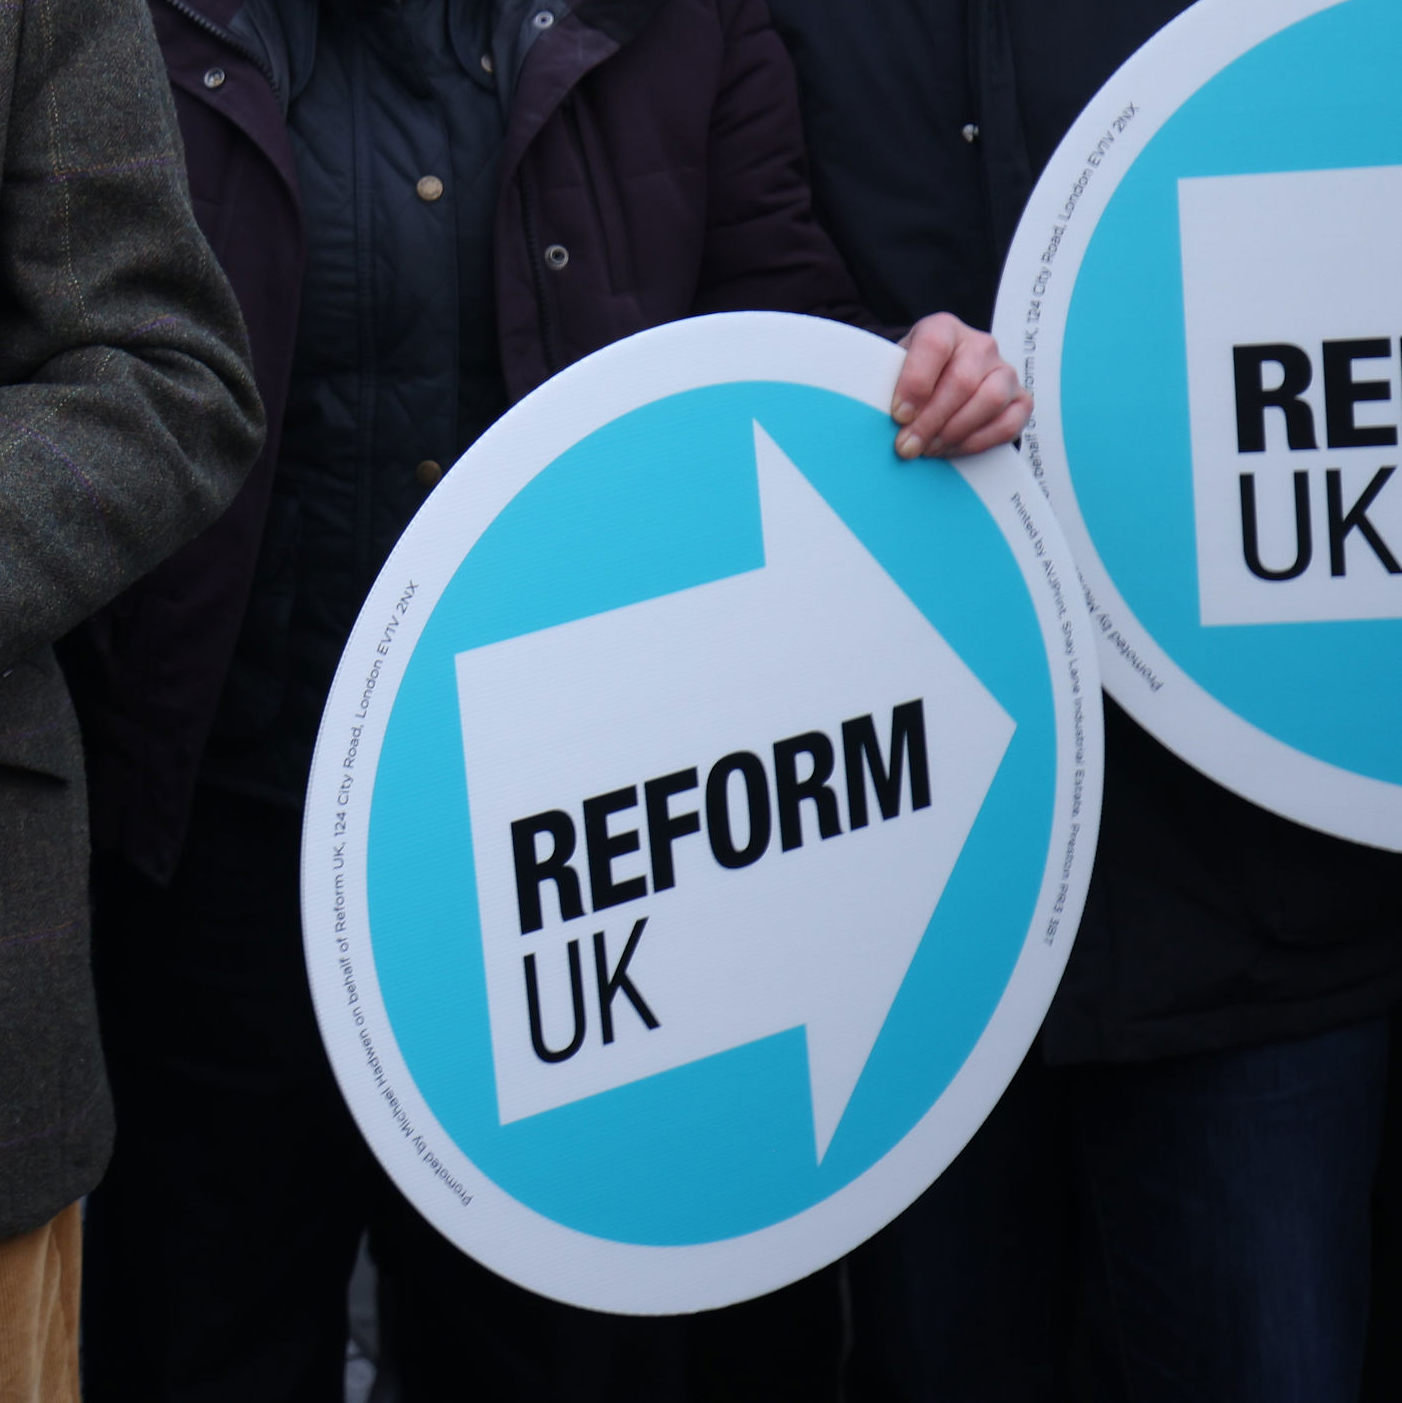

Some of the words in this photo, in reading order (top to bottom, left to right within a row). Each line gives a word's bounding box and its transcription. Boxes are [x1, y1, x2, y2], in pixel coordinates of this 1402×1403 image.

[1112, 101, 1140, 134] 2NX
[1058, 167, 1094, 222] London
[1041, 224, 1067, 265] Road,
[1033, 267, 1052, 297] City
[1011, 491, 1039, 539] Printed
[1239, 465, 1402, 582] UK
[1034, 537, 1046, 558] by
[396, 579, 420, 614] 2NX
[1062, 621, 1075, 656] Shay
[355, 658, 384, 719] London
[1068, 658, 1081, 694] Lane
[344, 724, 365, 769] Road,
[1073, 697, 1085, 765] Industrial
[338, 774, 354, 806] City
[335, 812, 346, 837] 124
[509, 696, 933, 935] REFORM
[1061, 822, 1081, 880] Preston
[333, 873, 346, 934] Reform
[337, 936, 349, 952] of
[339, 956, 359, 1008] behalf
[522, 916, 662, 1065] UK
[352, 1006, 365, 1026] on
[359, 1028, 387, 1088] Hadwen
[381, 1086, 414, 1137] Michael
[412, 1135, 427, 1155] by
[422, 1152, 474, 1207] Promoted
